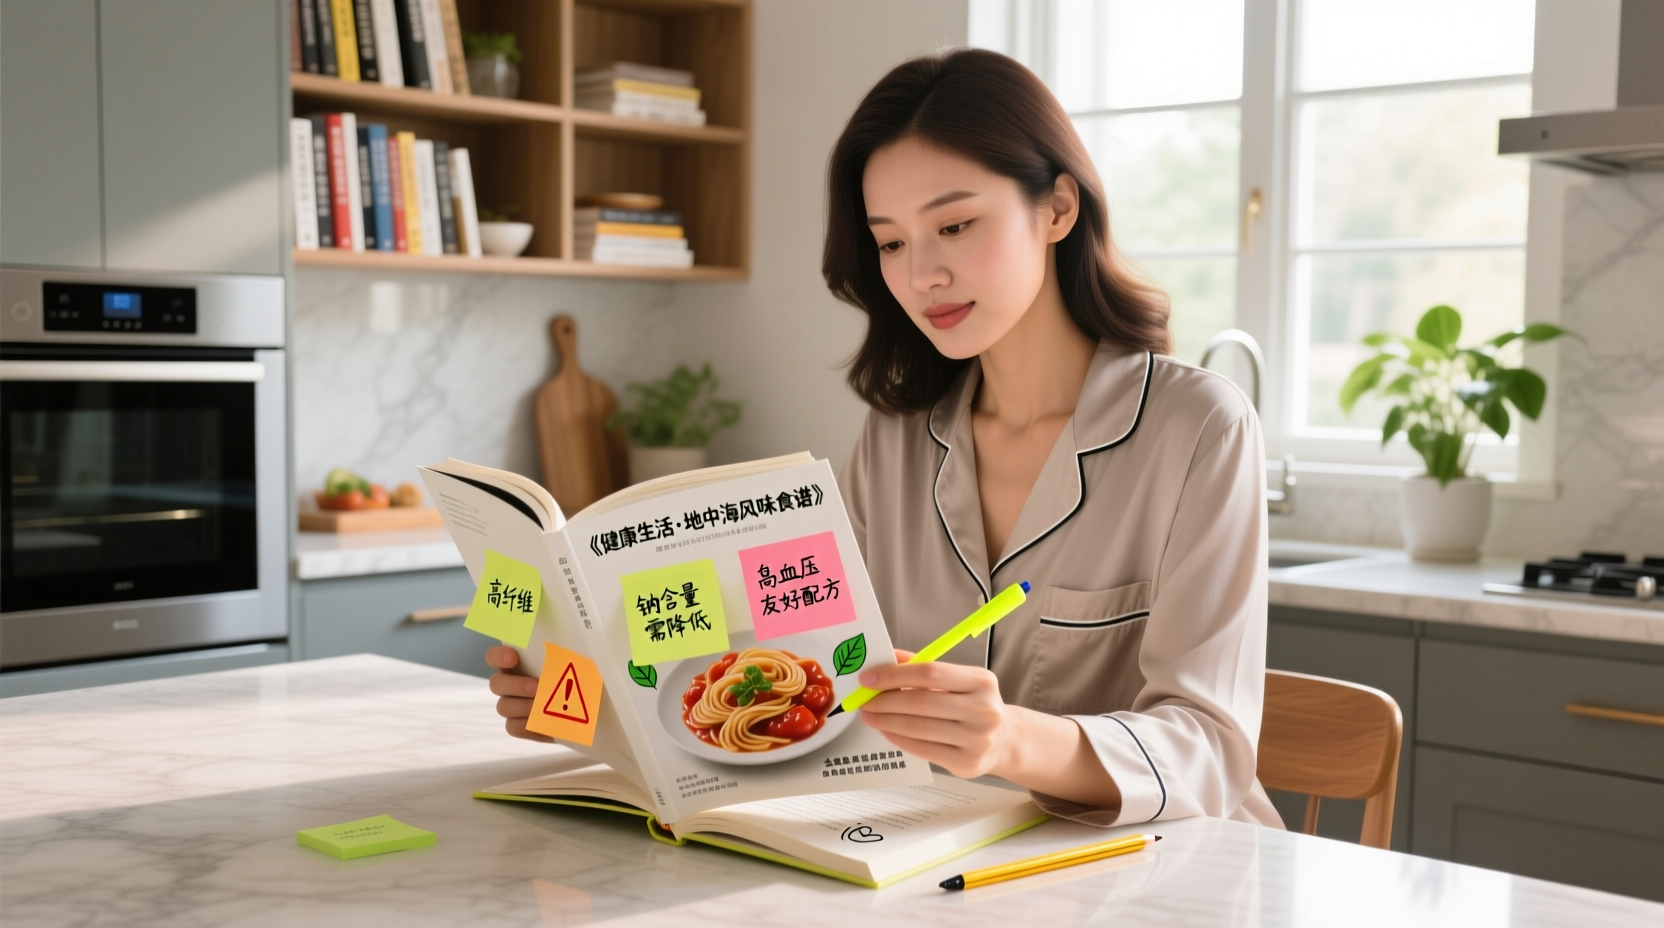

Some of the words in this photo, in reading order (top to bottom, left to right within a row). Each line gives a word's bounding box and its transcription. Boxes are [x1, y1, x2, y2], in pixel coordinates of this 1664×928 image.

[636, 581, 700, 617] 钠含量
[760, 578, 841, 617] 友好配方
[644, 609, 712, 643] 需降低
